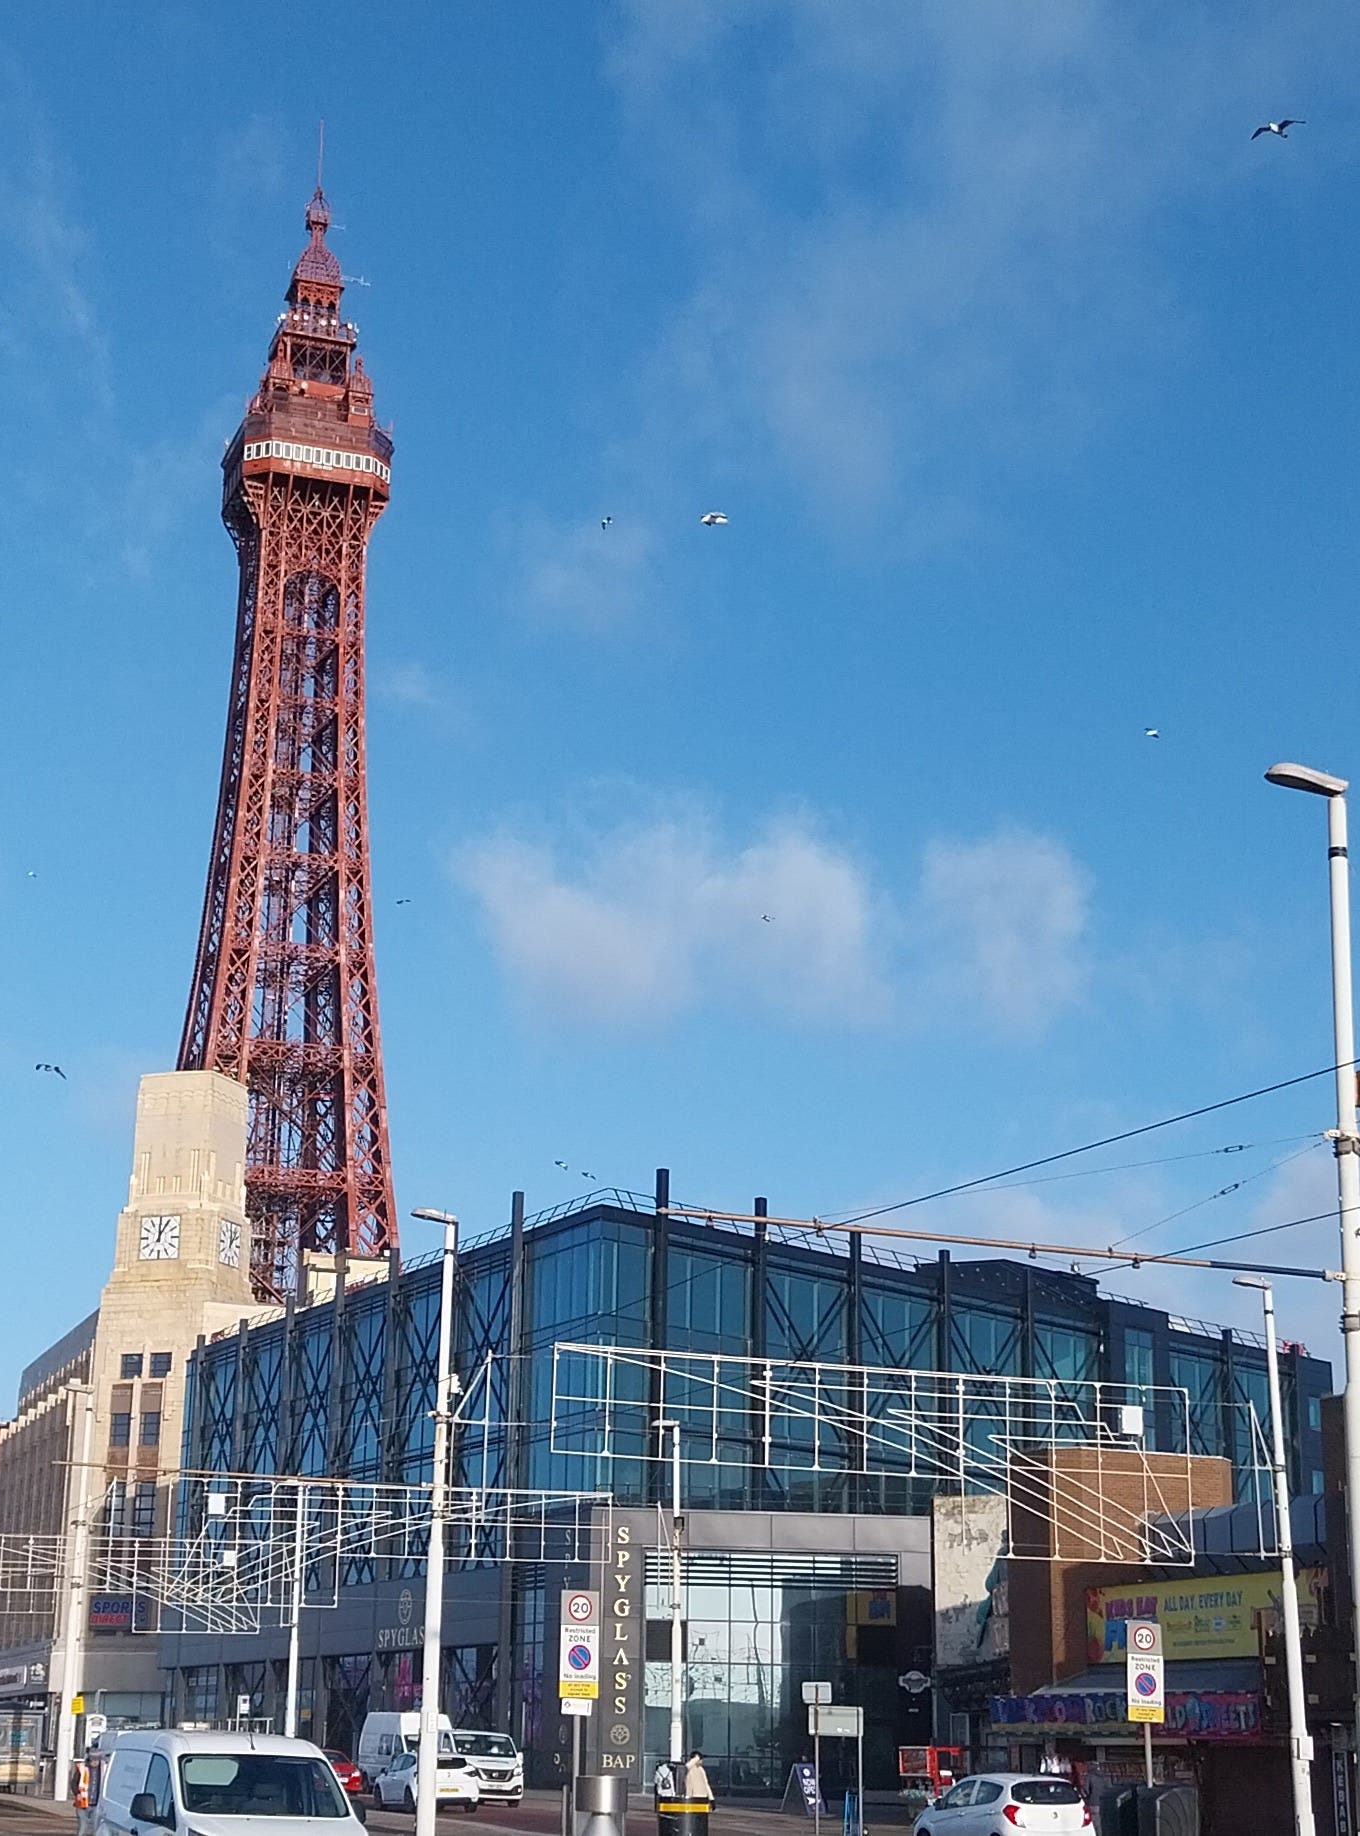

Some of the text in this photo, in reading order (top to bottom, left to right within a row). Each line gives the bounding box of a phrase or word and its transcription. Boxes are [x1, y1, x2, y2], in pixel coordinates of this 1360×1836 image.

[573, 1602, 589, 1613] 20
[1164, 1597, 1177, 1612] ALL
[1199, 1593, 1224, 1609] EVERY
[1226, 1591, 1243, 1606] DAY
[612, 1526, 631, 1714] SPYGLASS
[378, 1626, 425, 1648] SPYGLAS
[1137, 1633, 1152, 1644] 20
[1135, 1663, 1156, 1671] ZONE
[1336, 1760, 1347, 1833] KEBAB
